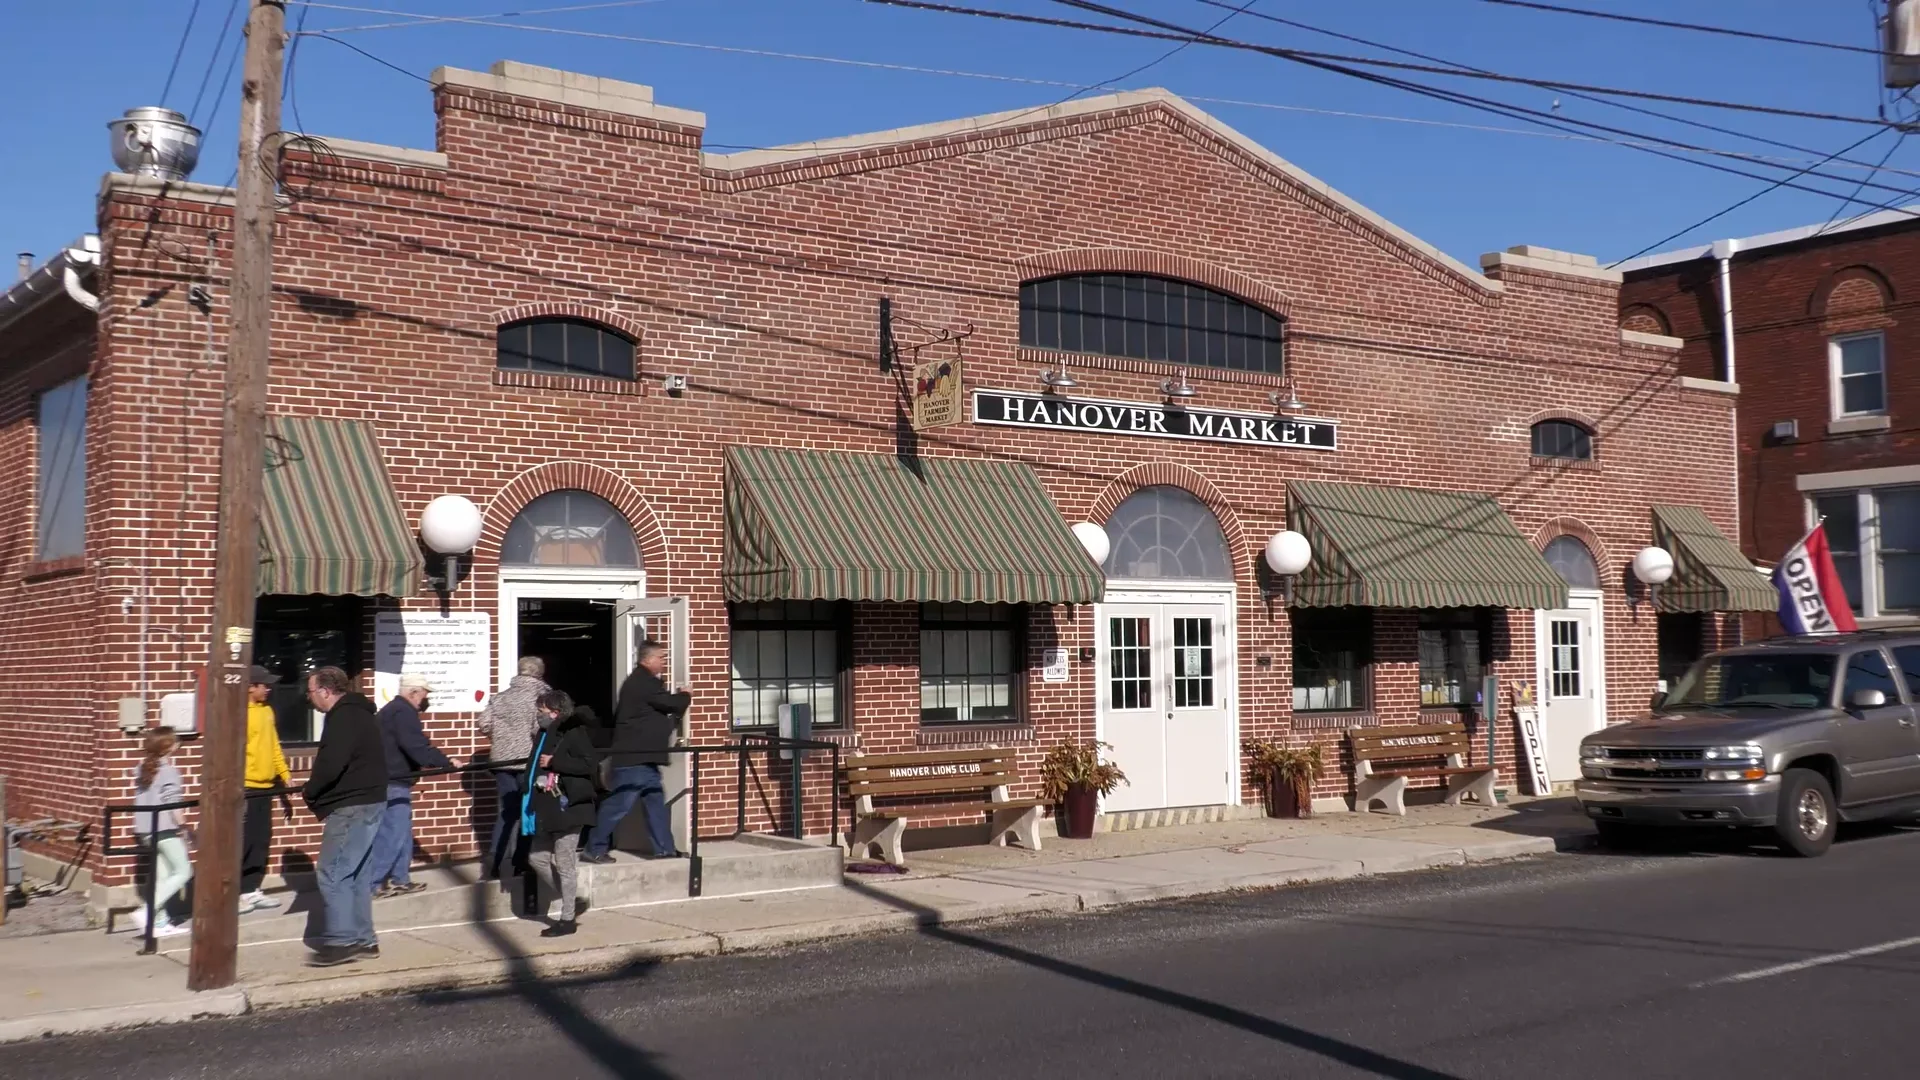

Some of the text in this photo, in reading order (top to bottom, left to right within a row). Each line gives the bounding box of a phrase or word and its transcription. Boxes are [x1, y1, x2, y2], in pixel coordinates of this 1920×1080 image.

[923, 399, 950, 409] HANOVER
[924, 406, 950, 416] FARMERS
[925, 414, 948, 423] MARKET
[1001, 397, 1317, 445] HANOVER MARKET
[1787, 557, 1830, 631] OPEN
[1054, 655, 1065, 664] PETS
[1046, 667, 1066, 676] ALLOWED
[224, 673, 242, 685] 22
[1525, 720, 1549, 794] OPEN
[890, 763, 981, 778] HANOVER LIONS CLUB
